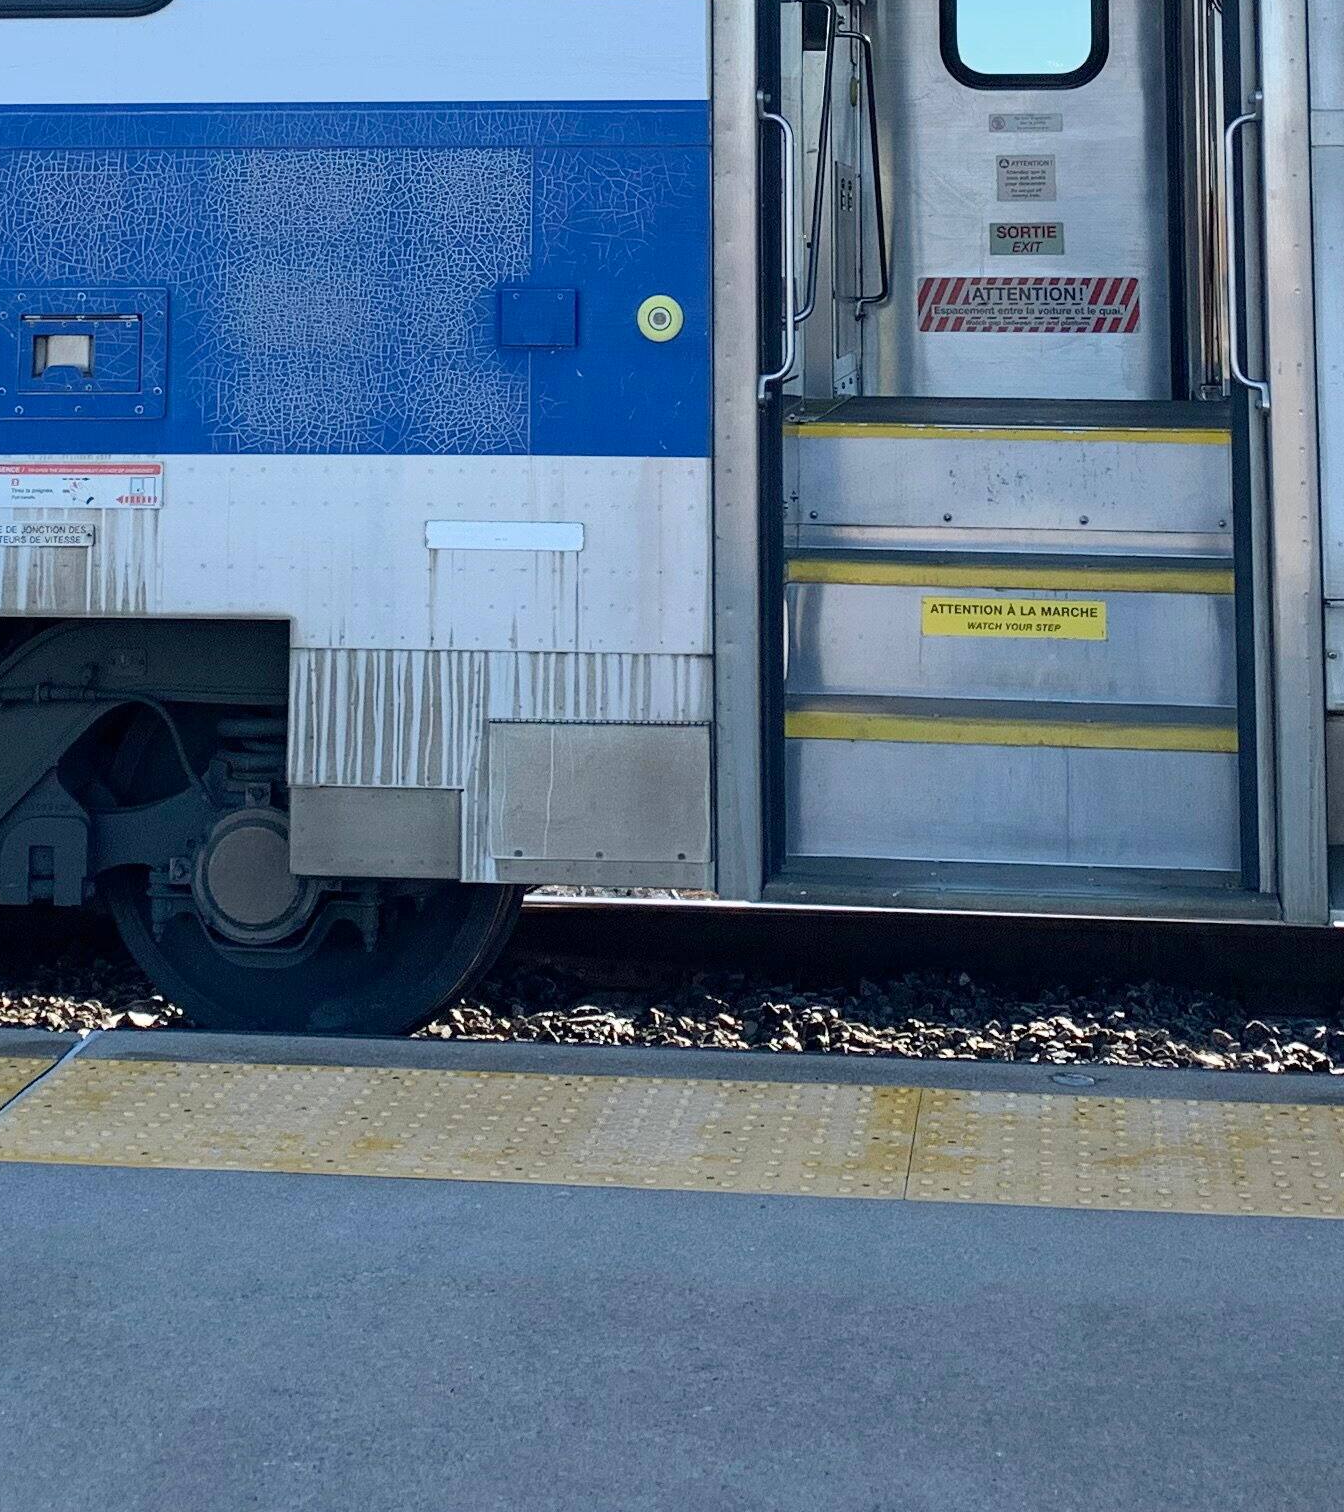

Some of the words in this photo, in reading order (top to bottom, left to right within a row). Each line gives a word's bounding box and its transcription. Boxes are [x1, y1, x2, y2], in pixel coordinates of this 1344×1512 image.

[996, 225, 1057, 239] SORTIE
[1012, 241, 1043, 253] EXIT
[934, 306, 996, 316] Espacement
[997, 307, 1023, 315] entre
[1025, 306, 1036, 315] la
[1038, 307, 1072, 315] voiture
[1074, 307, 1085, 315] et
[1087, 306, 1096, 315] le
[6, 525, 17, 534] DE
[21, 525, 66, 534] JONCTION
[68, 525, 87, 534] DES
[29, 535, 42, 544] DE
[44, 535, 81, 544] VITESSE
[930, 603, 1003, 616] ATTENTION
[1006, 603, 1016, 616] À
[1020, 606, 1036, 616] LA
[1041, 606, 1098, 618] MARCHE
[967, 621, 1002, 631] WATCH
[1006, 622, 1033, 631] YOUR
[1036, 624, 1062, 632] STEP
